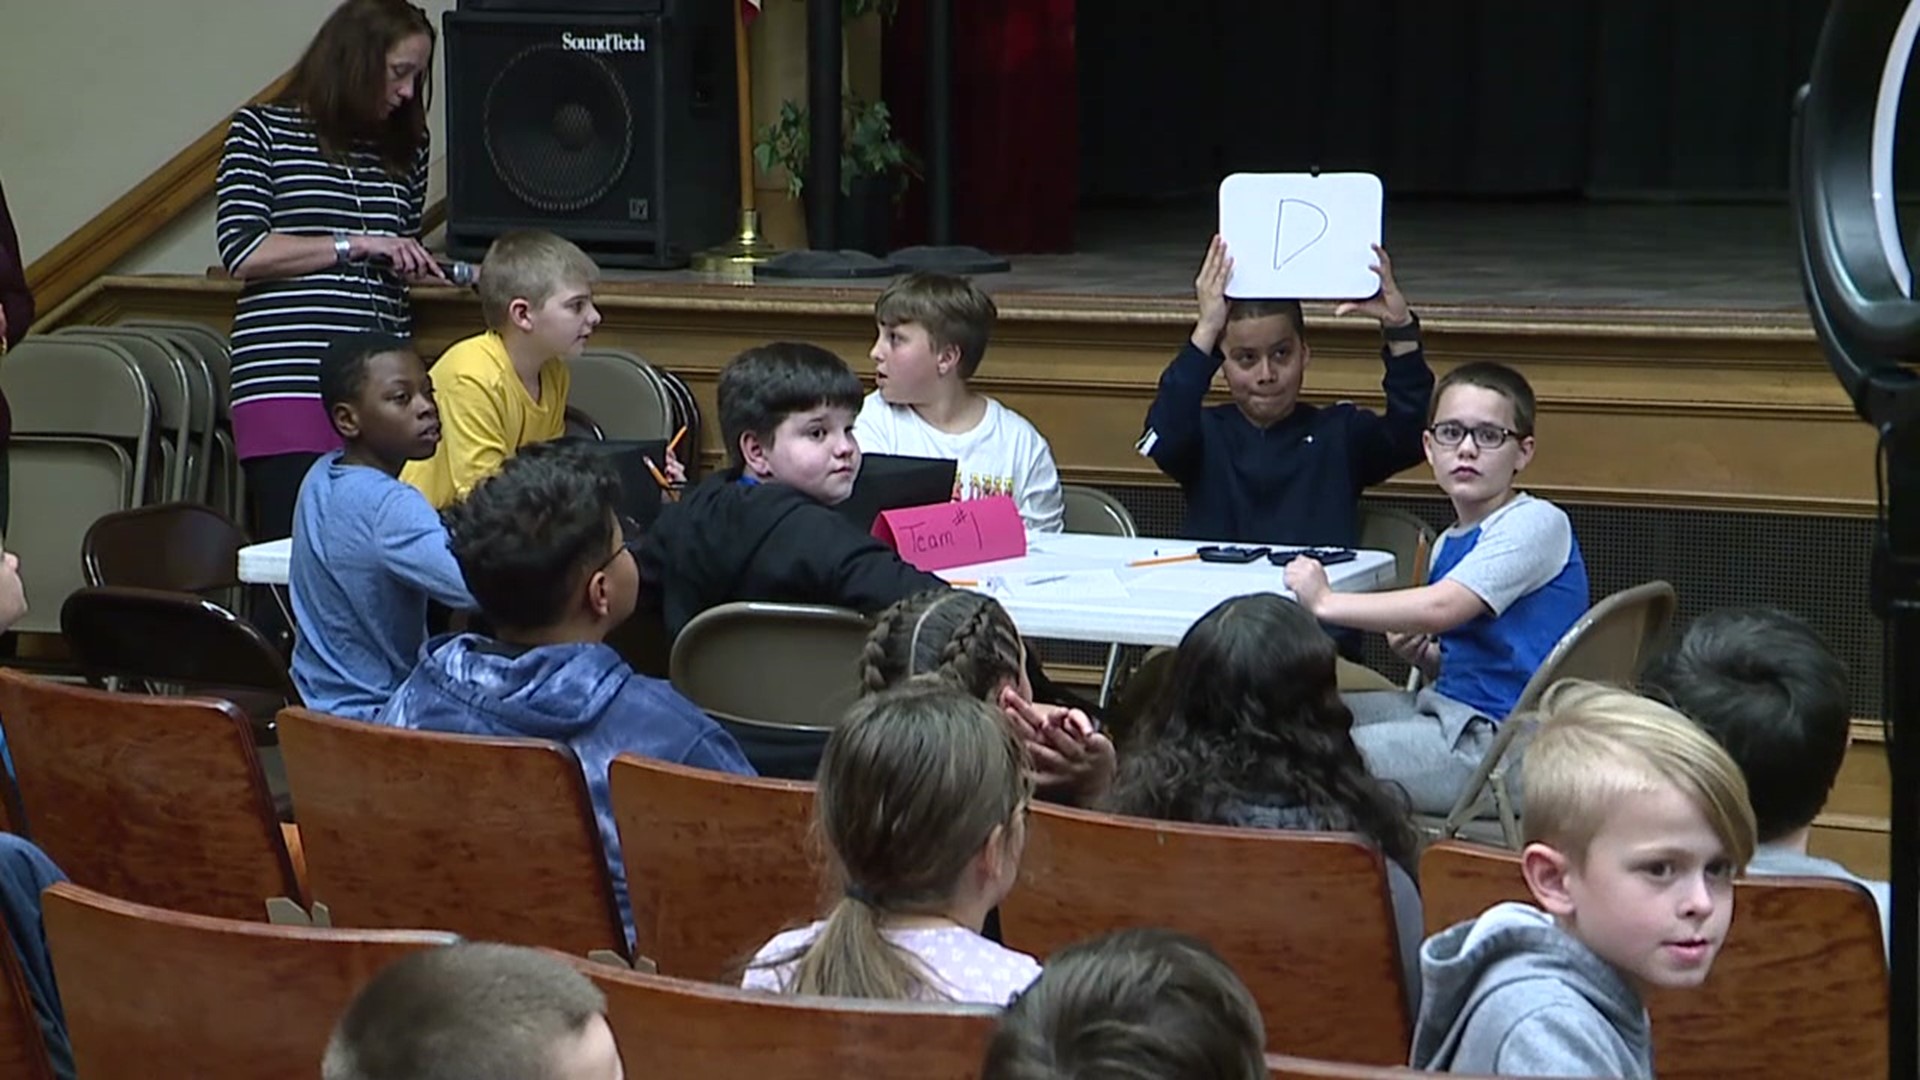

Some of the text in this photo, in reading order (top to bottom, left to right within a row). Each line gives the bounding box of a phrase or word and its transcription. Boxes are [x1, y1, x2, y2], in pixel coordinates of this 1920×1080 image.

[562, 32, 645, 53] SoundTech
[1273, 198, 1328, 270] D
[899, 521, 954, 553] Team
